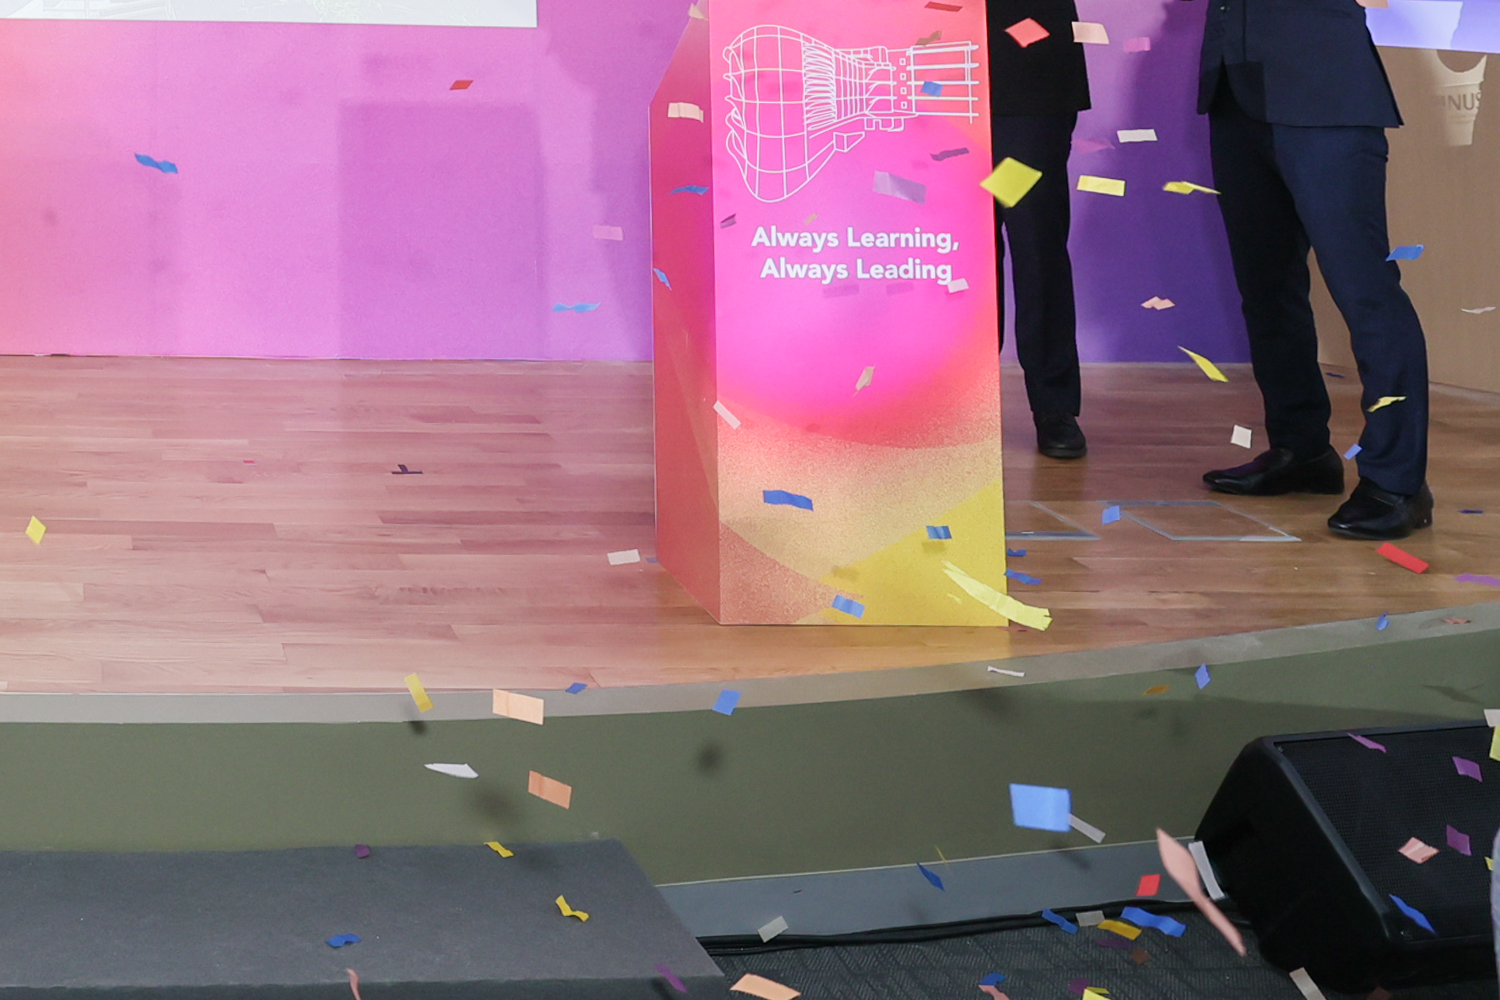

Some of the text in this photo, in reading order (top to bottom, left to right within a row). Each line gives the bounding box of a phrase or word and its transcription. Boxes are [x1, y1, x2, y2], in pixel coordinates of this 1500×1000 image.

[751, 225, 959, 254] Always Learning,
[760, 257, 952, 286] Always Leading
